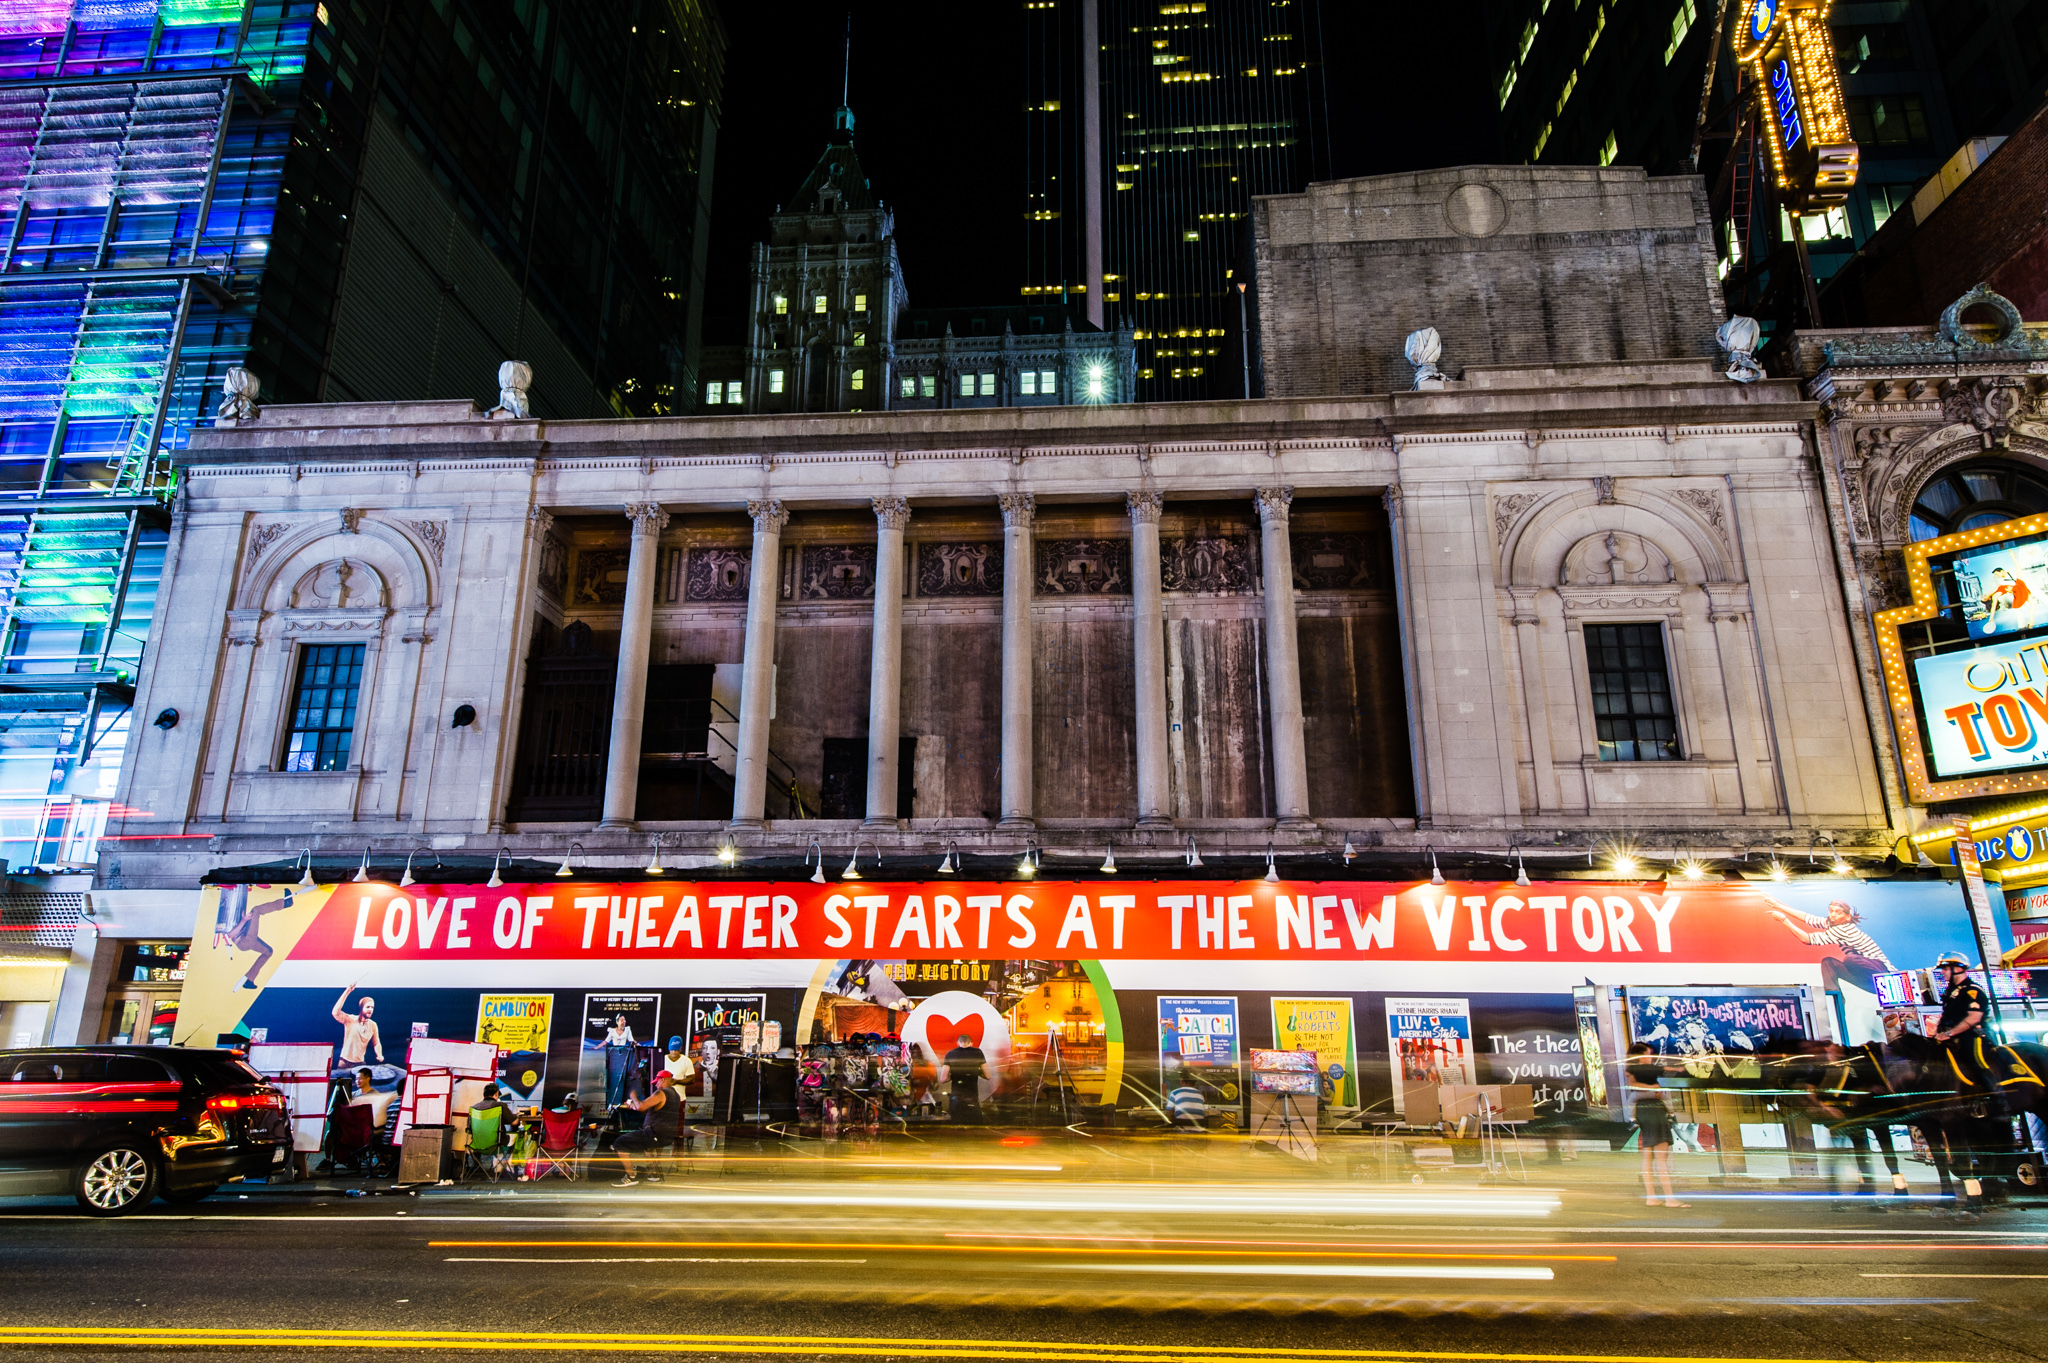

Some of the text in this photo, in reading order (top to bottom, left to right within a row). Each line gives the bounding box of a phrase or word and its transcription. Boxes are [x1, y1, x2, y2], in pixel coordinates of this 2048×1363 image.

[1772, 60, 1802, 150] LYRIC
[1962, 640, 2048, 693] ON T
[2006, 897, 2028, 912] NEW
[352, 895, 1682, 953] LOVE OF THEATER STARTS AT THE NEW VICTORY
[884, 963, 990, 981] NEW VICTORY
[1300, 1010, 1336, 1021] JUSTIN
[1672, 999, 1693, 1019] SEX
[1699, 999, 1734, 1022] DRUGS
[1734, 1007, 1769, 1030] ROCK
[1766, 1004, 1803, 1030] ROLL
[1179, 1016, 1231, 1034] CATCH
[1298, 1021, 1341, 1032] ROBERTS
[1398, 1016, 1427, 1030] LUV:
[1180, 1036, 1212, 1055] ME!
[1295, 1033, 1334, 1041] & THE NOT
[1488, 1035, 1581, 1054] The thea
[1507, 1062, 1583, 1084] you nev
[1532, 1084, 1586, 1113] utgro
